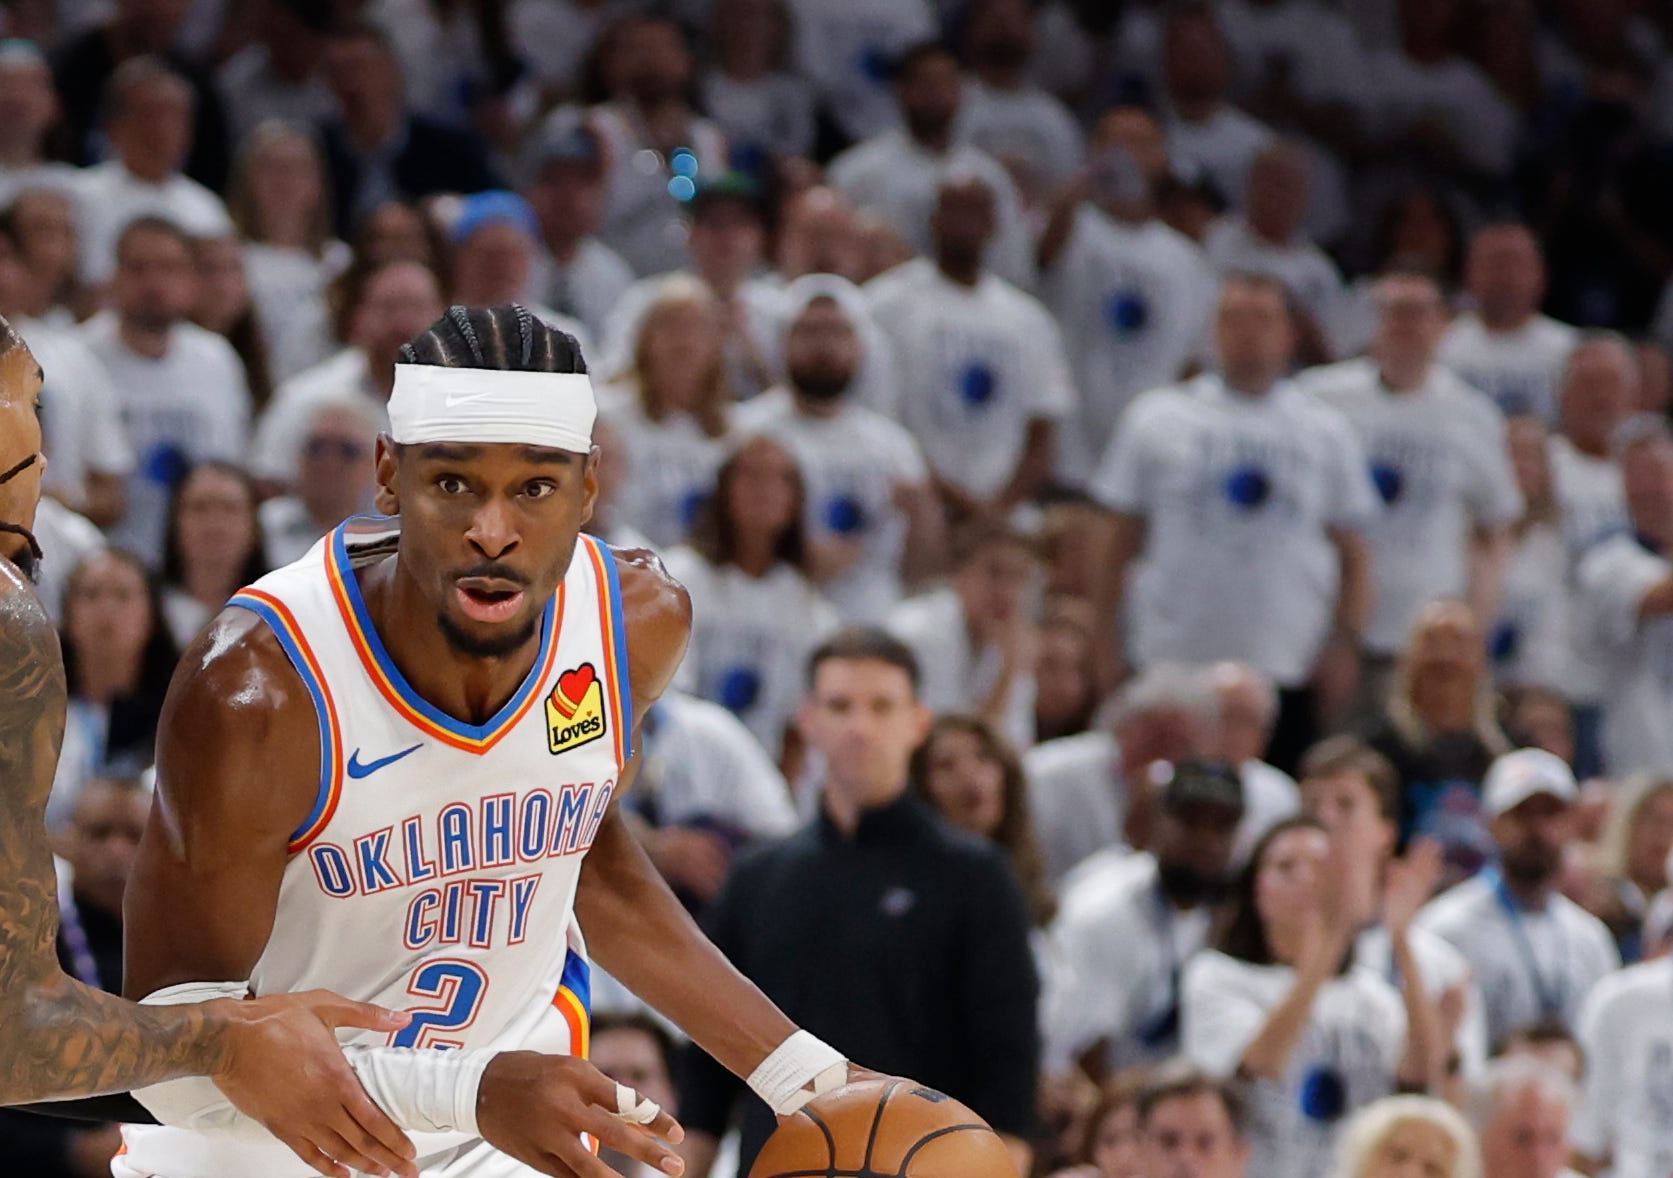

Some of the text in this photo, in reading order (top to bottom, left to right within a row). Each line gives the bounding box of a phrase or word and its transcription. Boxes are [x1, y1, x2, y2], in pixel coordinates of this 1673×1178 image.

[308, 779, 614, 899] OKLAHOMA
[403, 873, 543, 950] CITY
[386, 957, 490, 1050] 2
